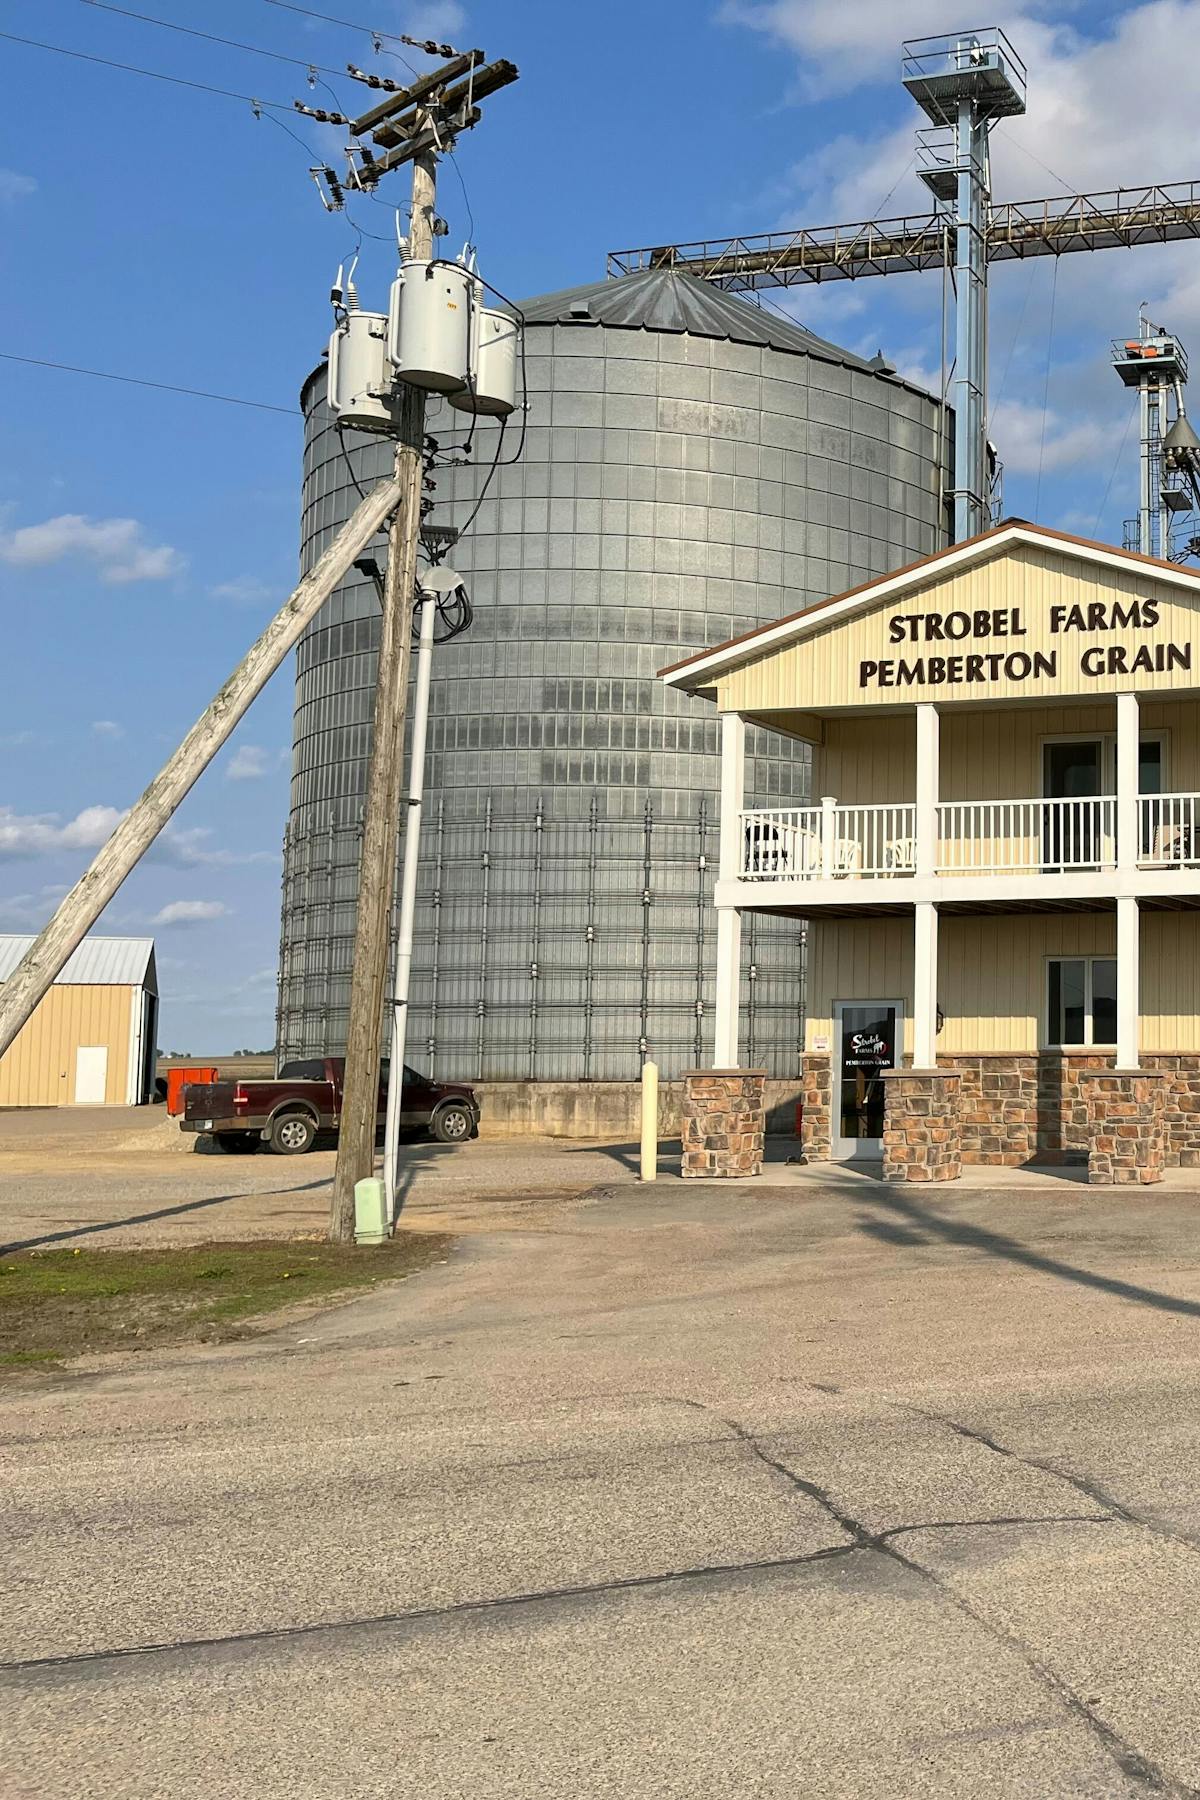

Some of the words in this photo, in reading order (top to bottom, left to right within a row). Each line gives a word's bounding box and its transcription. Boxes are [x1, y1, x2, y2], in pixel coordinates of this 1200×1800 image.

[889, 607, 1027, 643] STROBEL
[1050, 599, 1159, 633] FARMS
[859, 650, 1057, 687] PEMBERTON
[1081, 642, 1191, 676] GRAIN
